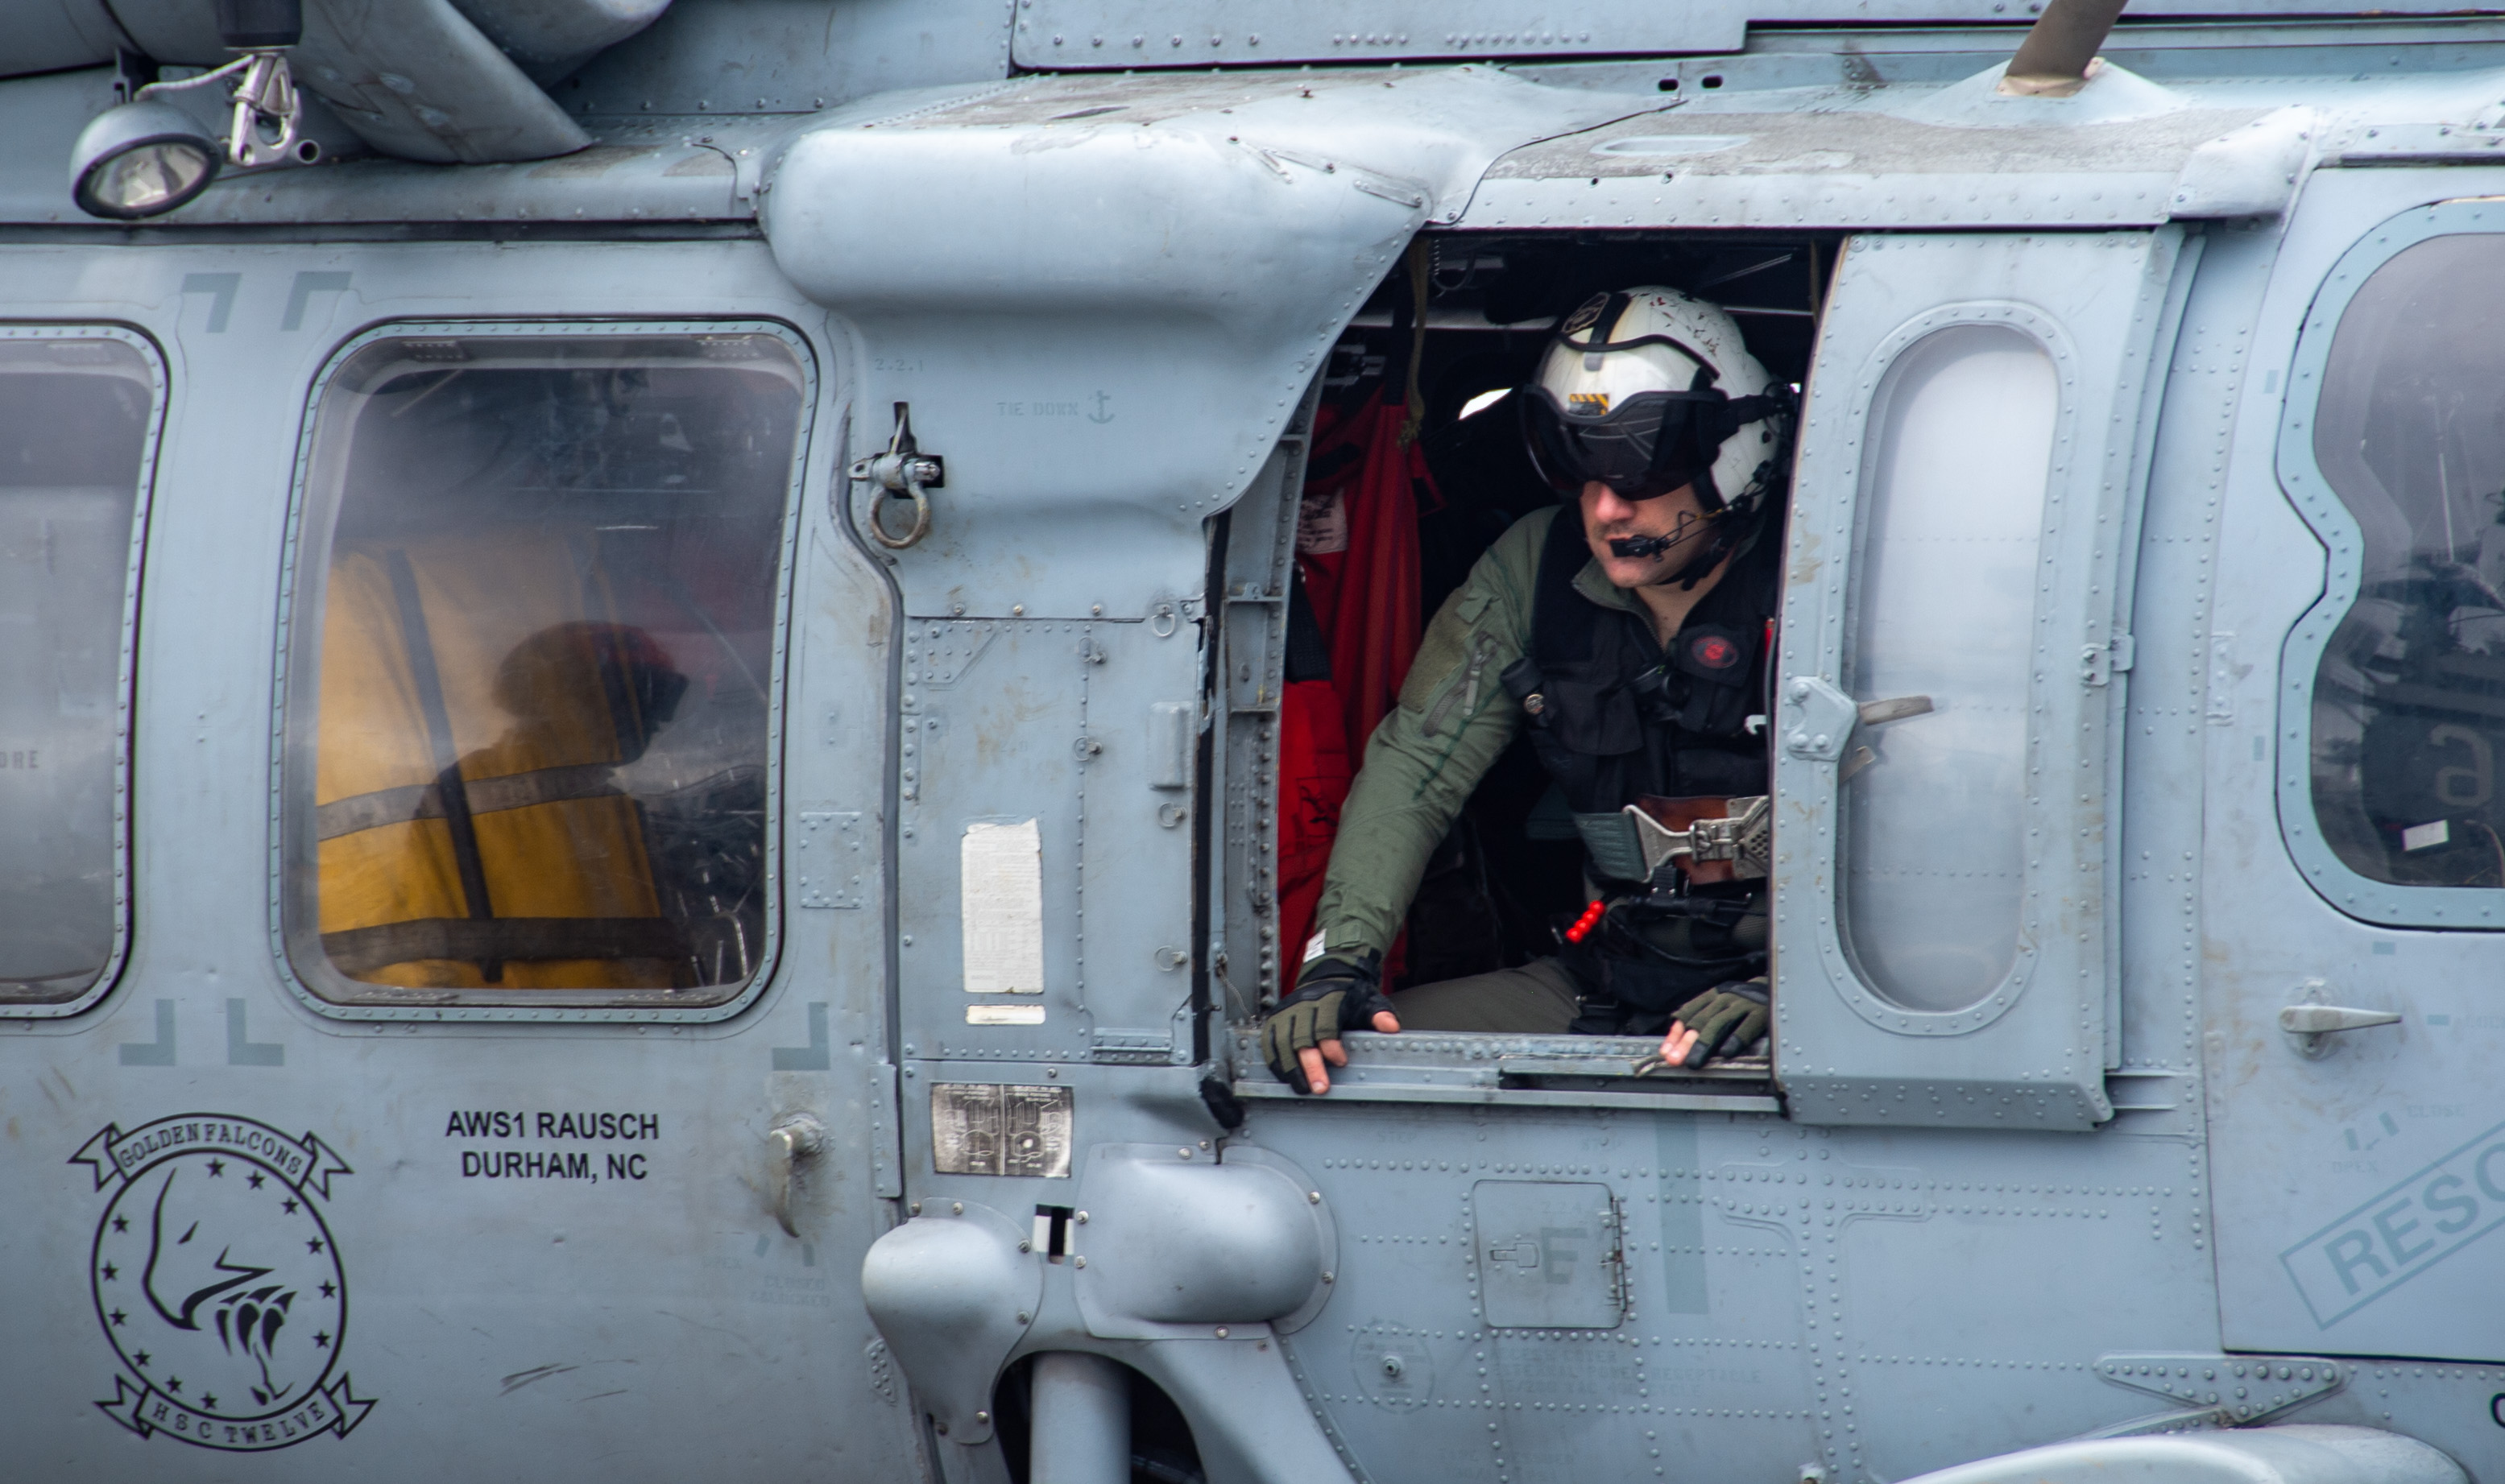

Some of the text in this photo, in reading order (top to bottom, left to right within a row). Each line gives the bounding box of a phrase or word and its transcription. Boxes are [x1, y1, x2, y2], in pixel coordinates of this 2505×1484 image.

[996, 401, 1025, 416] TIE
[445, 1110, 660, 1140] AWS1 RAUSCH
[462, 1151, 648, 1184] DURHAM, NC
[1540, 1227, 1588, 1285] E
[224, 1399, 325, 1444] TWELVE
